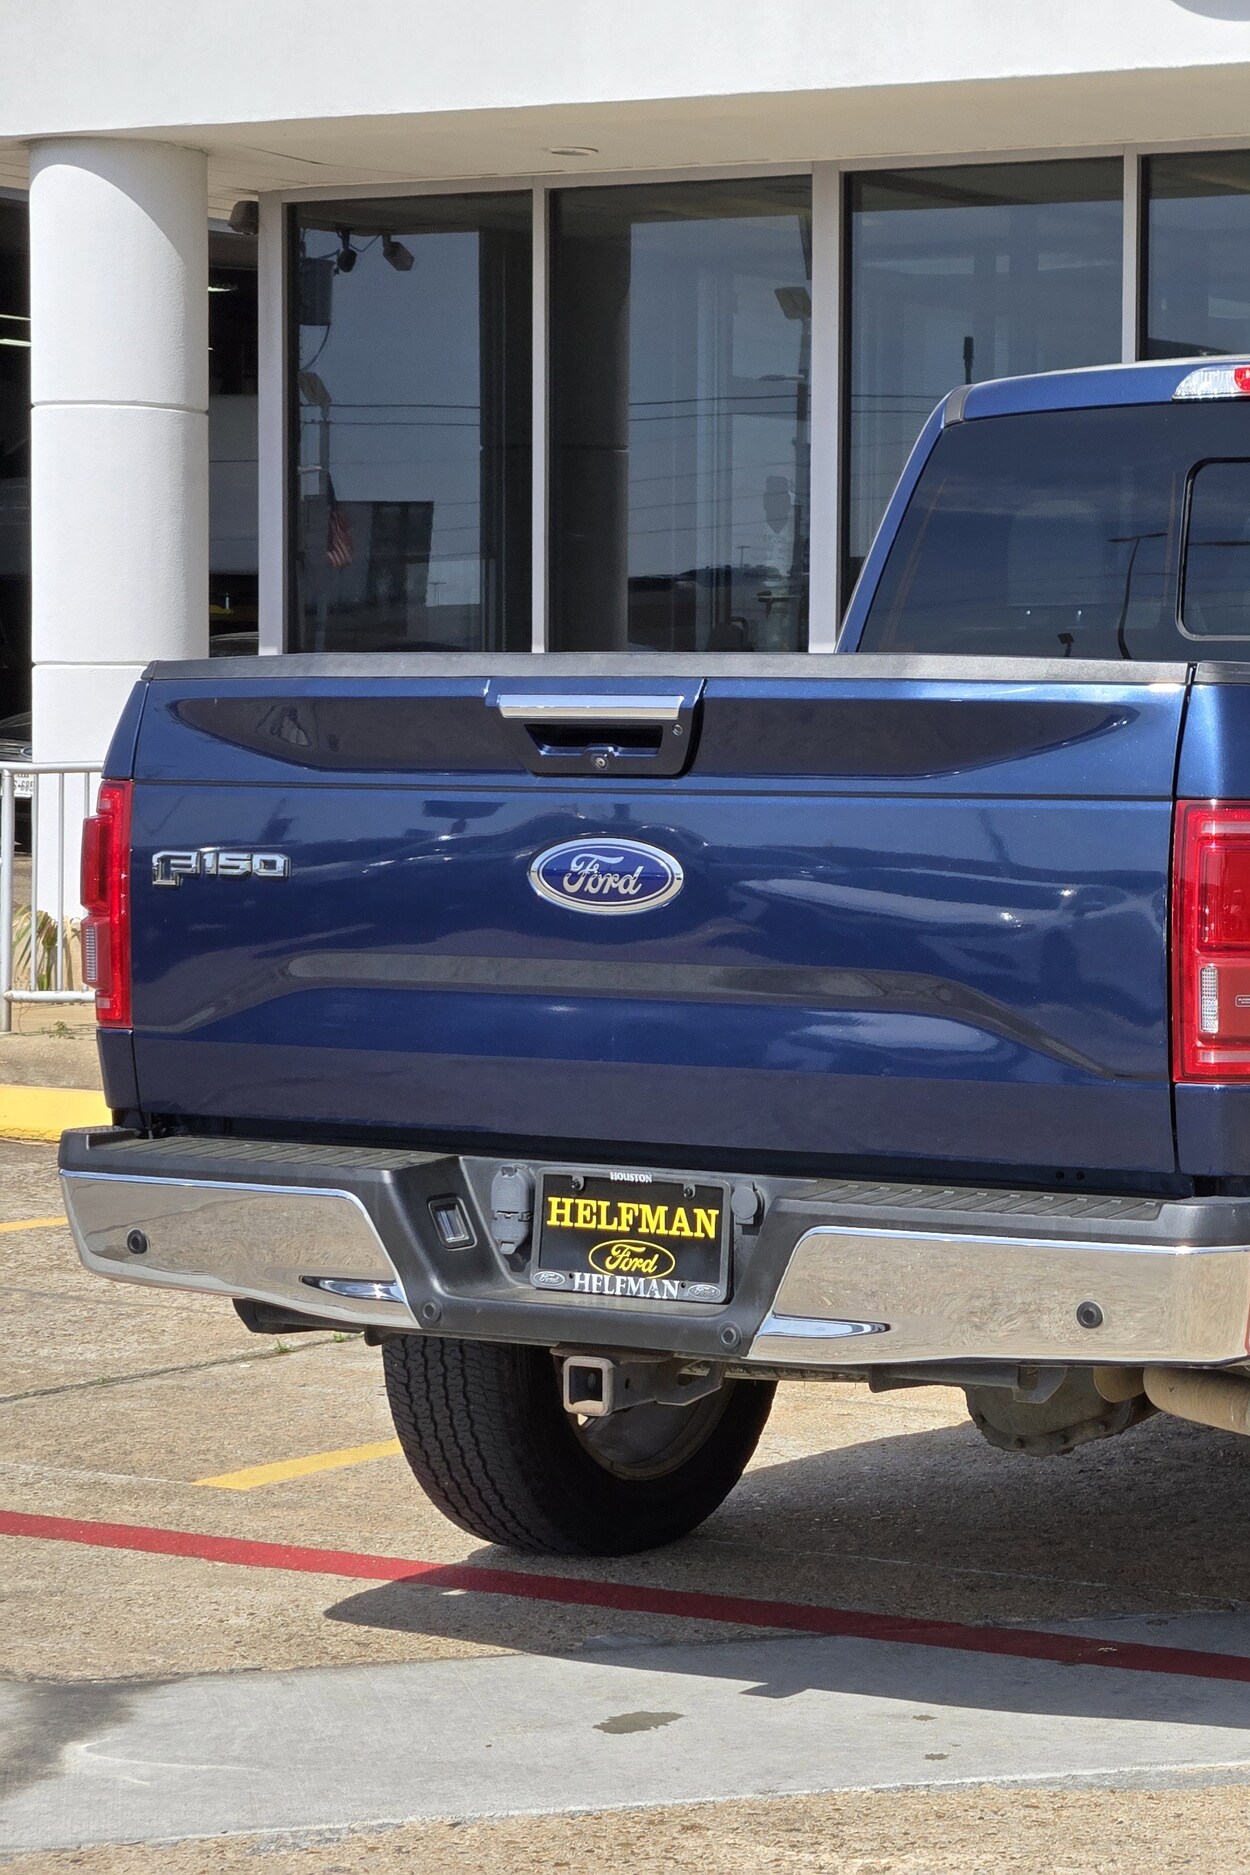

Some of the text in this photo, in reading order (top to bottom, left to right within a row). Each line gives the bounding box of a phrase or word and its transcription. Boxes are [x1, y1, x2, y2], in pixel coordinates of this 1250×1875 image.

[562, 852, 642, 895] Ford
[609, 1170, 653, 1183] HOUSTON
[546, 1196, 720, 1239] HELFMAN
[604, 1242, 660, 1274] Ford
[572, 1273, 680, 1300] HELFMAN
